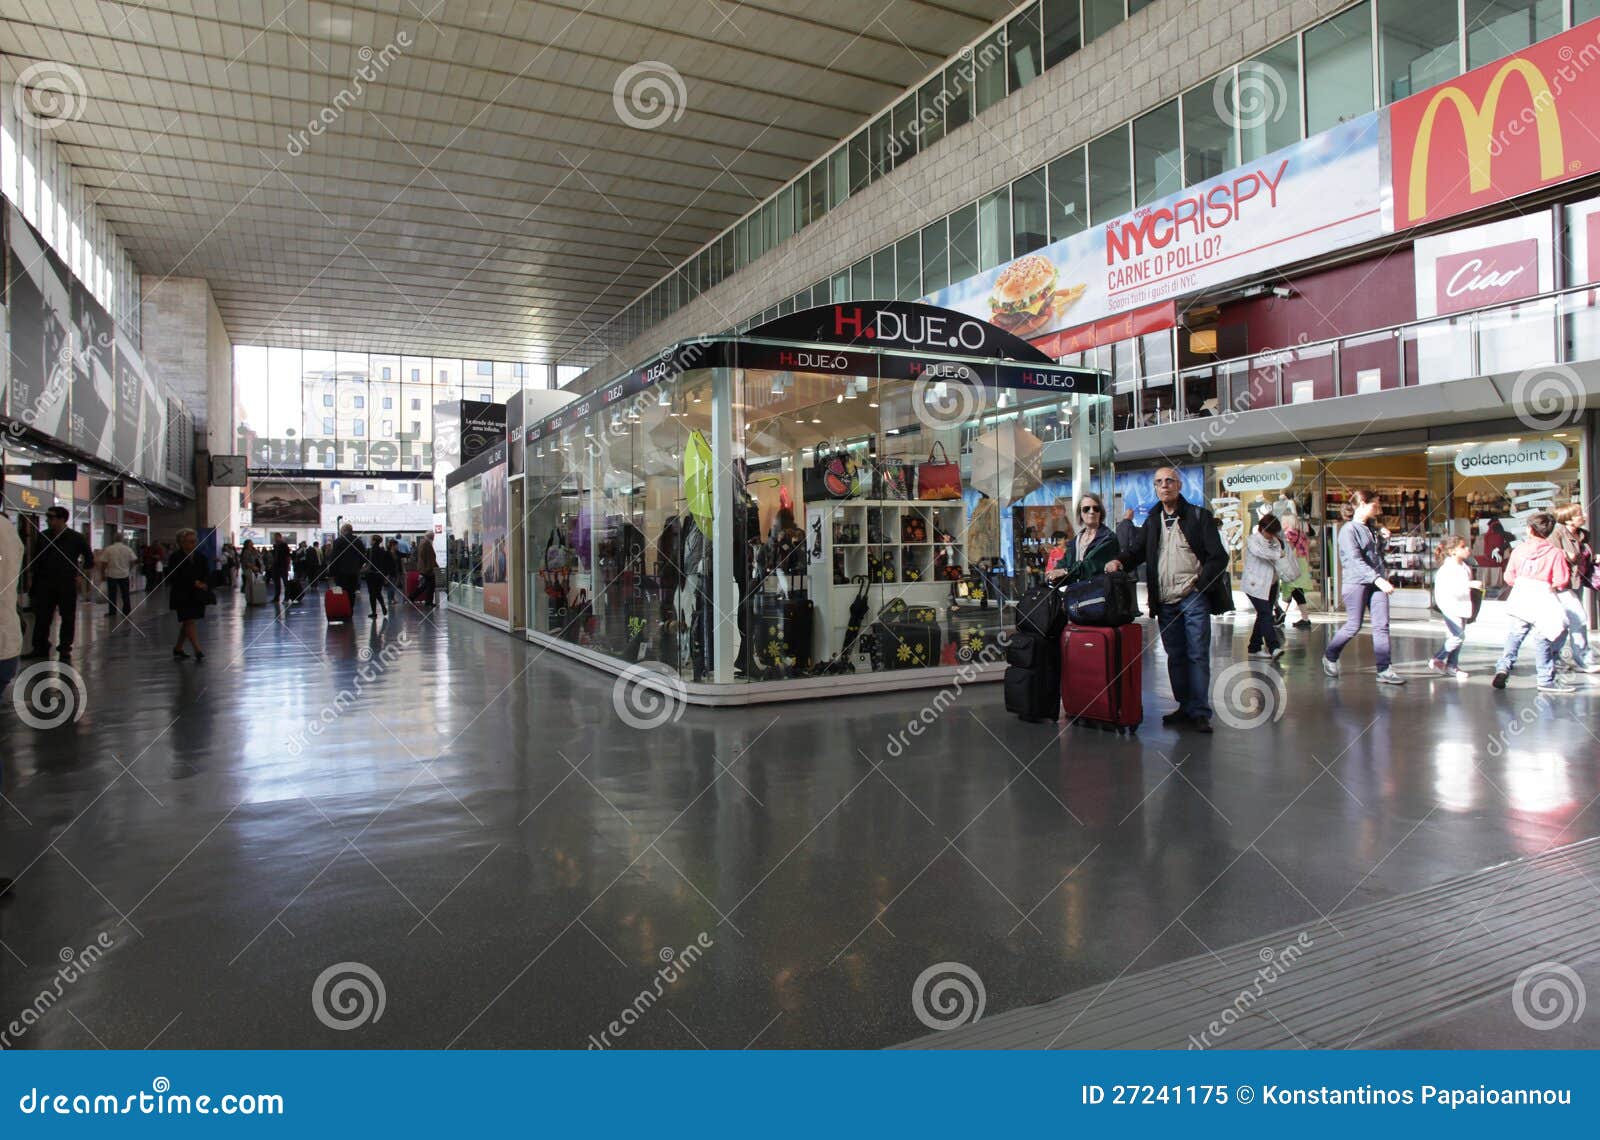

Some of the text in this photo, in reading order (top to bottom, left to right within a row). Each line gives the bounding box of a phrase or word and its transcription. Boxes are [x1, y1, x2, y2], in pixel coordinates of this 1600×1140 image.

[1106, 208, 1152, 232] NEW YORK
[1108, 235, 1222, 290] CARNE O POLLO?
[1446, 259, 1524, 297] Ciao
[1108, 294, 1130, 311] Scopri
[1132, 289, 1147, 304] tutti
[1151, 283, 1170, 299] gusti
[834, 306, 985, 350] H.DUE.O
[780, 352, 848, 370] H.DUE.O
[909, 362, 969, 379] H.DUE.O
[1023, 372, 1075, 388] H.DUE.O
[1461, 449, 1546, 469] goldenpoint
[1226, 472, 1281, 487] goldenpoint
